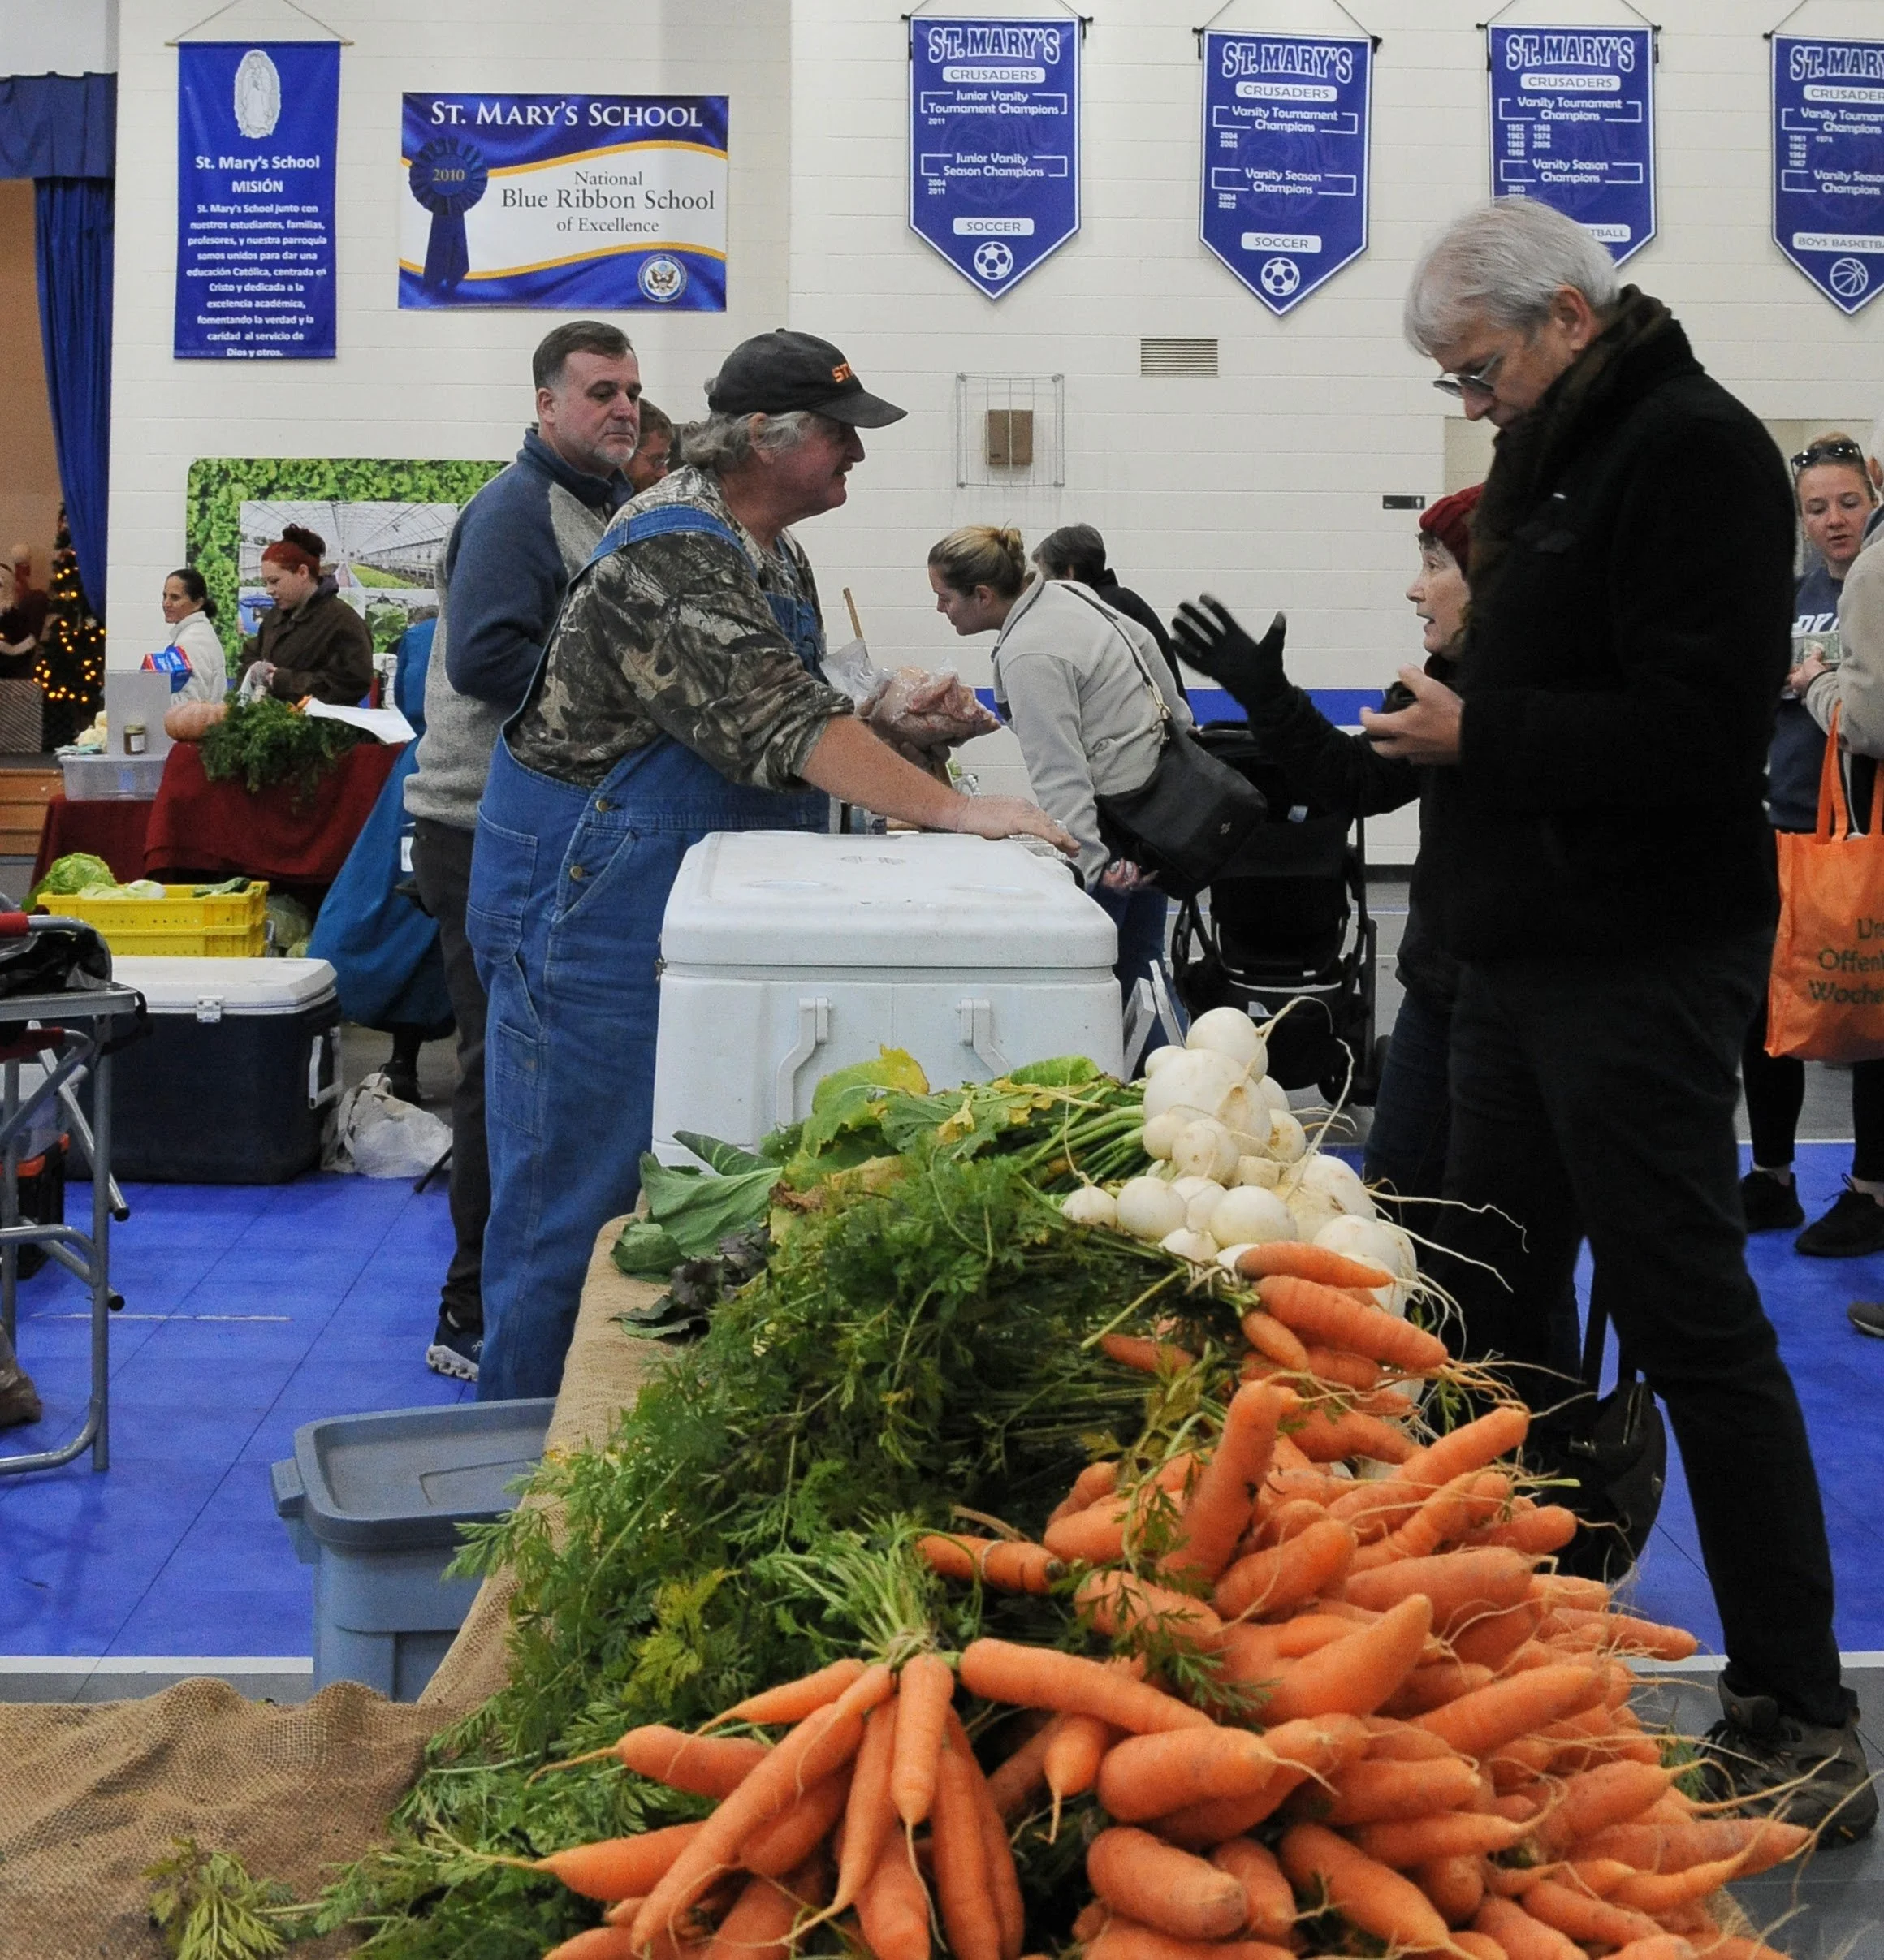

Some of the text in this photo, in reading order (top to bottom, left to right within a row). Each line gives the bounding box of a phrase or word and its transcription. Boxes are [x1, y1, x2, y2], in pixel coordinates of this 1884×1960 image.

[950, 69, 1037, 80] CRUSADERS
[1528, 76, 1613, 88] CRUSADERS
[956, 90, 1028, 103] Junior Varsity
[1243, 84, 1329, 98] CRUSADERS
[1811, 88, 1884, 101] CRUSADER
[928, 103, 1058, 115] Tournament Champions
[1517, 96, 1623, 109] Varsity Tournament
[1232, 105, 1338, 121] Varsity Tournament
[1540, 110, 1601, 122] Champions
[1800, 107, 1837, 121] Varsity
[1255, 119, 1316, 132] Champions
[1823, 121, 1882, 134] Champions
[196, 155, 214, 170] St.
[271, 155, 320, 170] School
[956, 153, 1028, 166] Junior Varsity
[1532, 158, 1609, 171] Varsity Season
[432, 169, 465, 182] 2010
[944, 165, 1044, 179] Season Champions
[1245, 168, 1322, 183] Varsity Season
[1540, 171, 1601, 183] Champions
[1813, 169, 1851, 183] Varsity
[232, 177, 283, 192] MISIÓN
[574, 171, 643, 187] National
[1253, 182, 1313, 195] Champions
[1821, 182, 1881, 196] Champions
[501, 188, 715, 210] Blue Ribbon School
[244, 204, 274, 213] School
[274, 205, 300, 214] junto
[190, 221, 228, 230] nuestros
[556, 218, 659, 233] of Excellence
[966, 222, 1021, 231] SOCCER
[1591, 228, 1627, 237] TBALL
[239, 238, 244, 246] y
[282, 236, 327, 246] parroquia
[1255, 236, 1308, 248] SOCCER
[1798, 237, 1827, 246] BOYS
[227, 252, 257, 260] unidos
[259, 253, 280, 261] para
[282, 252, 297, 260] dar
[186, 267, 231, 276] educación
[274, 268, 314, 276] centrada
[209, 283, 235, 291] Cristo
[236, 284, 242, 293] y
[244, 283, 285, 291] dedicada
[295, 283, 305, 291] la
[206, 299, 253, 308] excelencia
[197, 315, 314, 326] fomentando la verdad y la
[207, 331, 304, 340] caridad al servicio de
[227, 348, 248, 356] Dios
